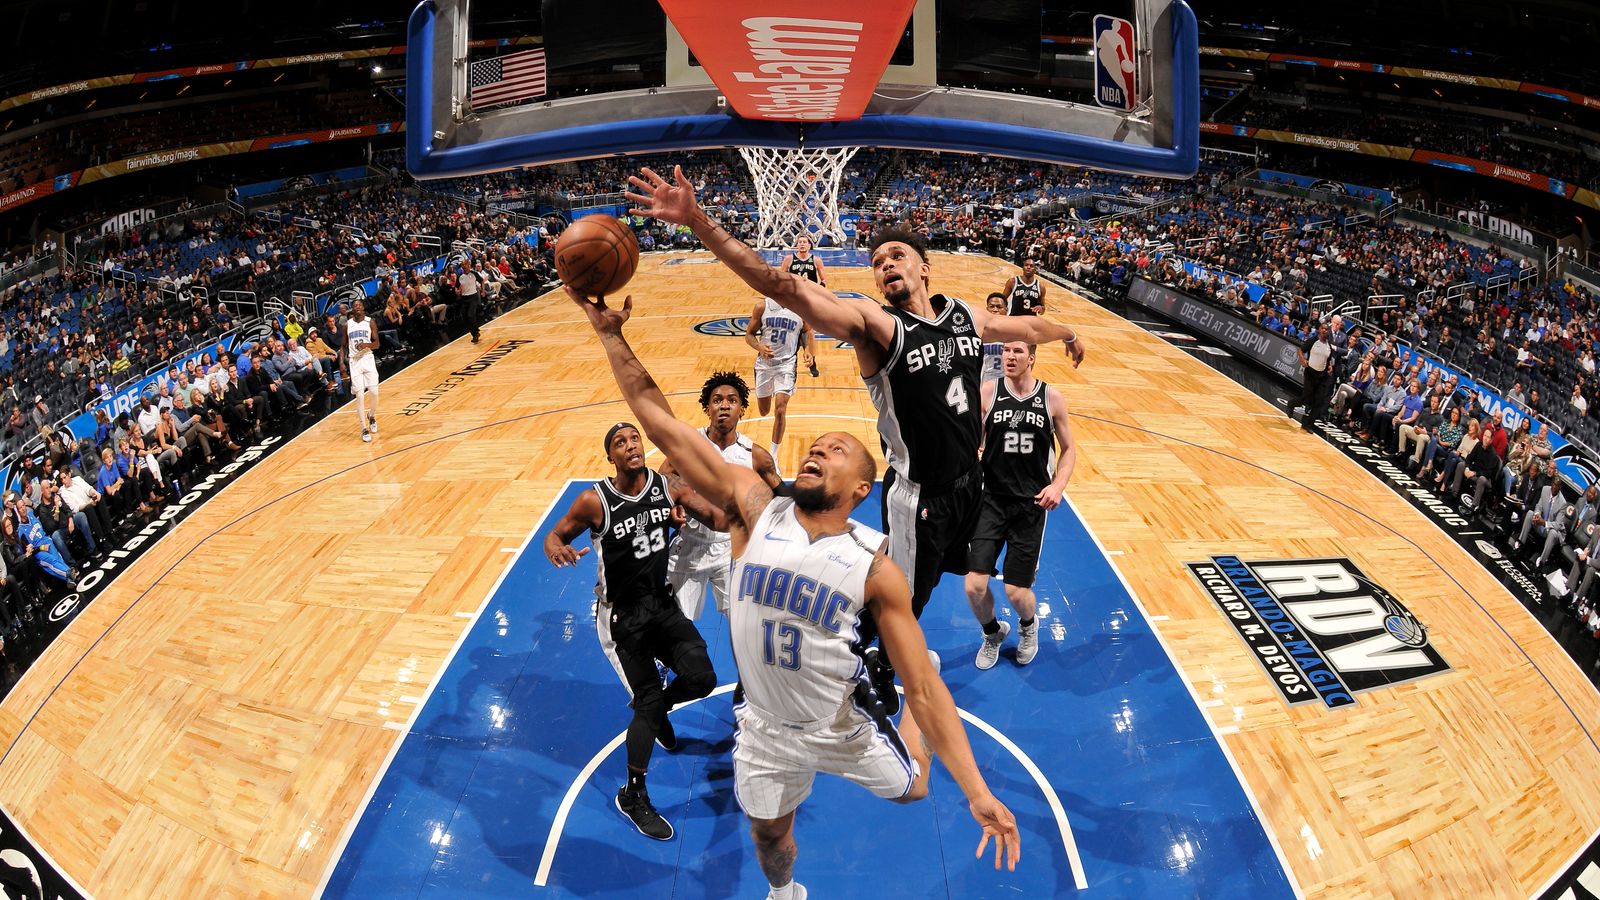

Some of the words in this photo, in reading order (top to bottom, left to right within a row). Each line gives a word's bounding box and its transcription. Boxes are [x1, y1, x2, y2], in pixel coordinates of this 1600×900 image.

[286, 52, 344, 64] fairwinds.org/magic
[1422, 70, 1478, 84] fairwinds.org/magic
[31, 81, 89, 100] fairwinds.org/magic
[1101, 85, 1121, 104] NBA
[334, 128, 361, 137] FAIRWINDS
[1294, 134, 1360, 150] fairwinds.org/magic
[127, 148, 199, 170] fairwinds.org/magic
[1500, 167, 1531, 181] FAIRWINDS
[2, 187, 36, 206] FAIRWINDS
[500, 201, 525, 211] FLORIDA
[1023, 299, 1031, 310] 3
[765, 316, 798, 332] MAGIC
[951, 323, 972, 334] Frost
[1147, 288, 1161, 303] AT
[1180, 303, 1198, 323] DEC
[1200, 310, 1214, 328] 21
[1213, 324, 1224, 333] AT
[1224, 321, 1271, 356] 7:30PM
[349, 329, 369, 341] MAGIC
[906, 336, 982, 374] SPURS
[1273, 359, 1296, 377] FLORIDA
[396, 377, 465, 417] CENTER
[944, 374, 970, 415] 4
[993, 409, 1045, 429] SPURS
[1478, 390, 1525, 432] MAGI
[1004, 431, 1035, 454] 25
[1347, 445, 1382, 458] OF
[1366, 459, 1422, 487] PURE
[1406, 488, 1470, 527] MAGIC
[650, 494, 665, 502] Frost
[612, 507, 671, 540] SPURS
[632, 526, 666, 560] 33
[828, 551, 854, 569] Disney
[1496, 562, 1542, 605] HOSPITAL
[1501, 559, 1543, 598] FLORIDA
[738, 562, 851, 634] MAGIC
[1252, 562, 1435, 673] RDV
[1196, 566, 1252, 620] RICHARD
[1241, 624, 1265, 641] M.
[1257, 645, 1308, 696] DEVOS
[1215, 557, 1295, 634] ORLANDO
[1282, 640, 1351, 707] MAGIC
[762, 618, 803, 672] 13
